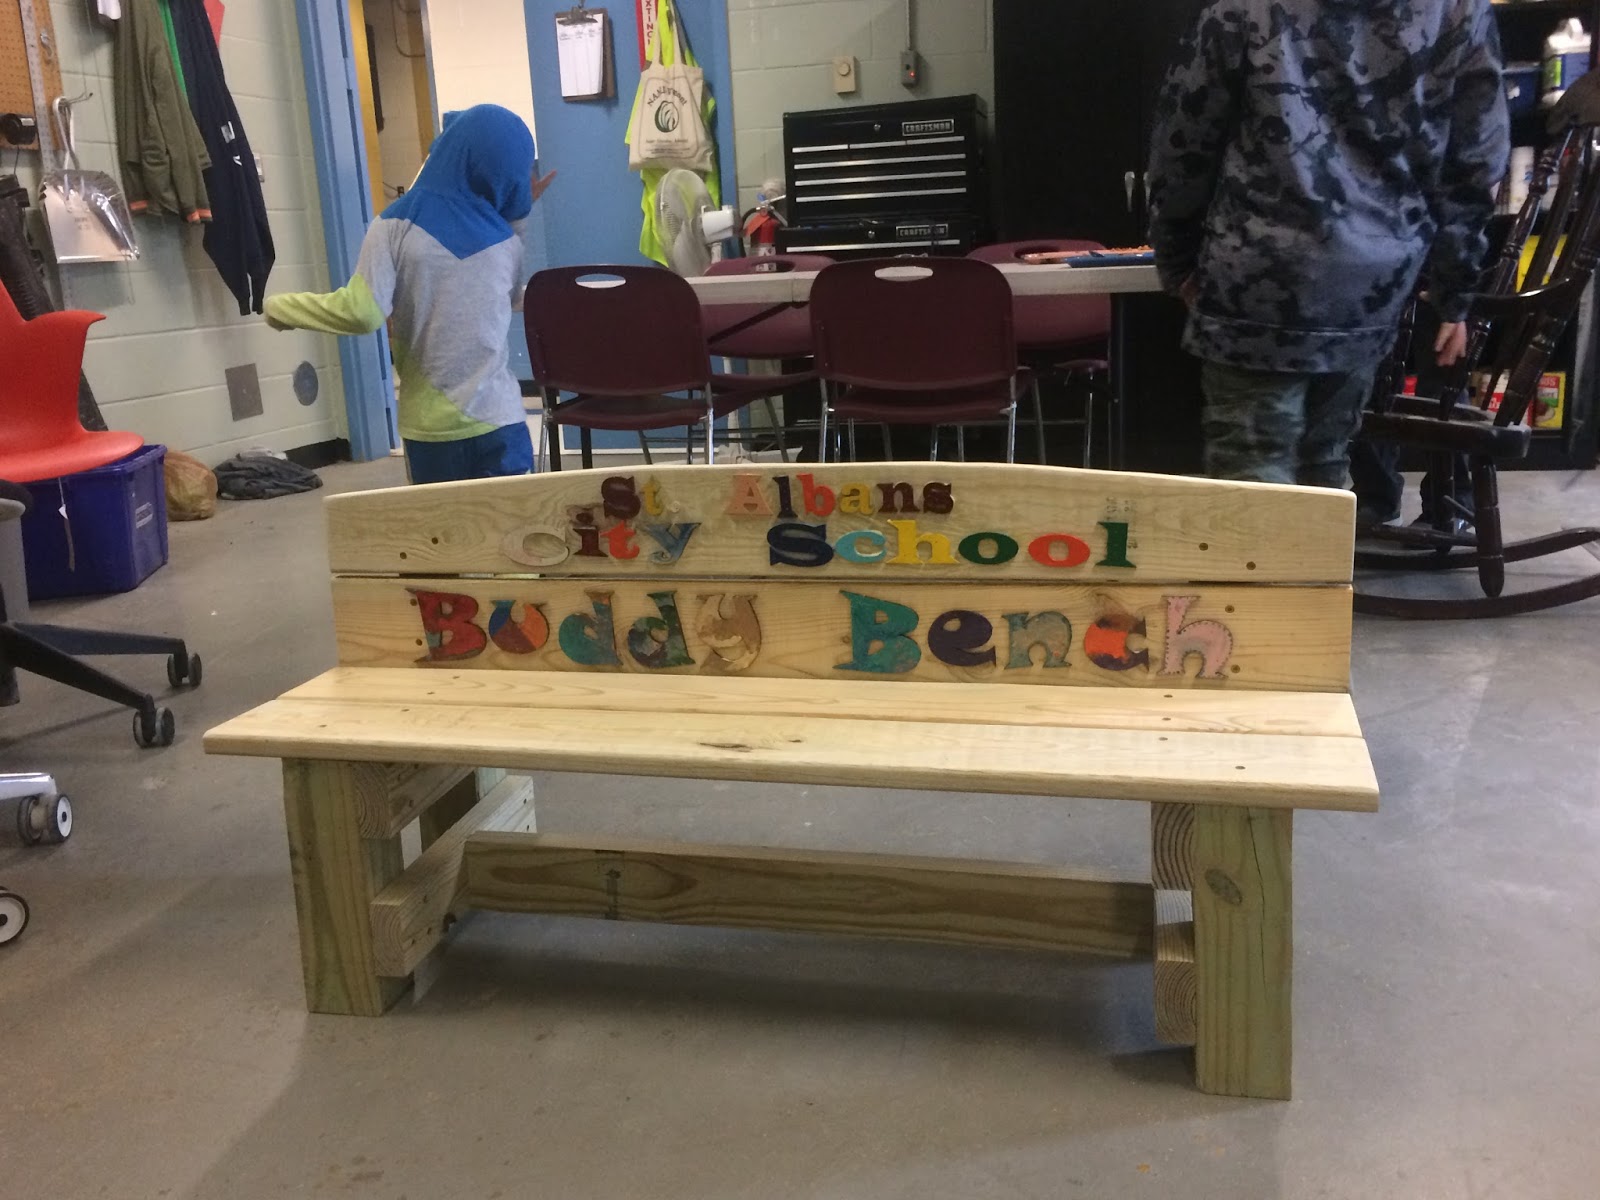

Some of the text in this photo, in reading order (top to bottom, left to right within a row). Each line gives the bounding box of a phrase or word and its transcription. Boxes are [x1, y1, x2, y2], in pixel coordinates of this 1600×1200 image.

[905, 121, 950, 132] CRAFTSMAN
[600, 473, 955, 519] St Albans
[503, 511, 1136, 569] City School
[405, 587, 1234, 680] Buddy Bench
